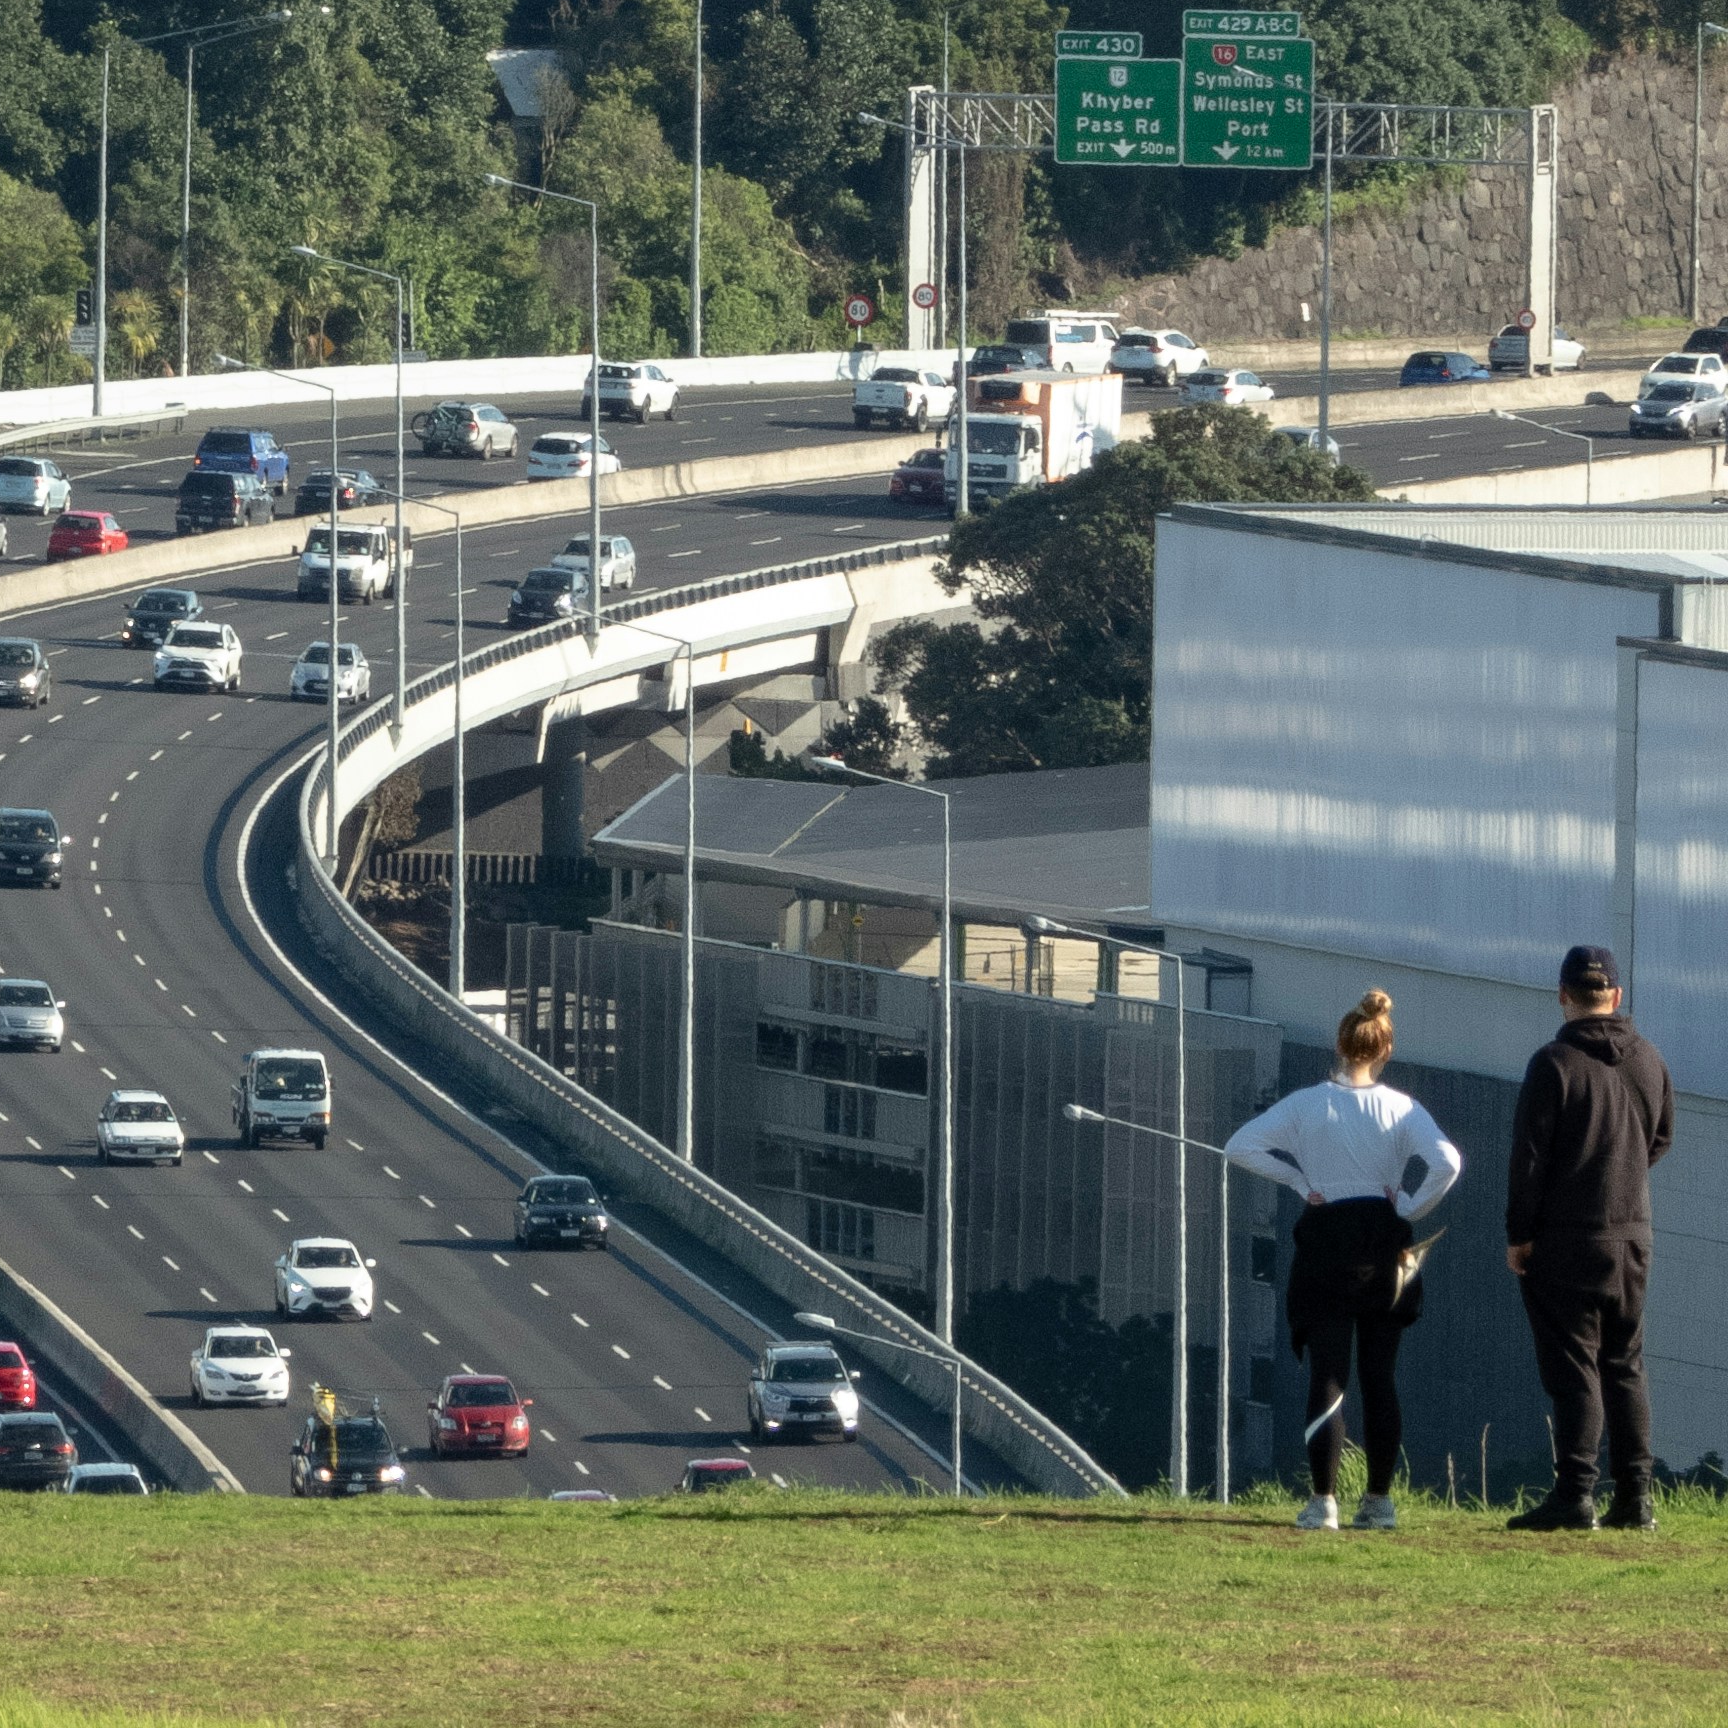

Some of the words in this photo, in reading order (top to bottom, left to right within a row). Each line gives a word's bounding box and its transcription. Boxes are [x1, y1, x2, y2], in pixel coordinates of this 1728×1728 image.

[1189, 17, 1213, 29] EXIT
[1217, 16, 1251, 32] 429
[1062, 38, 1091, 50] EXIT
[1096, 37, 1135, 53] 430
[1216, 47, 1233, 61] 16
[1245, 45, 1285, 61] EAST
[1284, 74, 1303, 89] St
[1082, 92, 1155, 113] Khyber
[1193, 95, 1275, 117] Wellesley
[1284, 98, 1304, 113] St
[1076, 116, 1124, 133] Pass
[1135, 118, 1160, 134] Rd
[1227, 120, 1270, 137] Port
[1076, 141, 1105, 153] EXIT
[1140, 141, 1164, 155] 500
[1264, 146, 1285, 158] km
[918, 291, 933, 302] 80
[851, 304, 867, 317] 80
